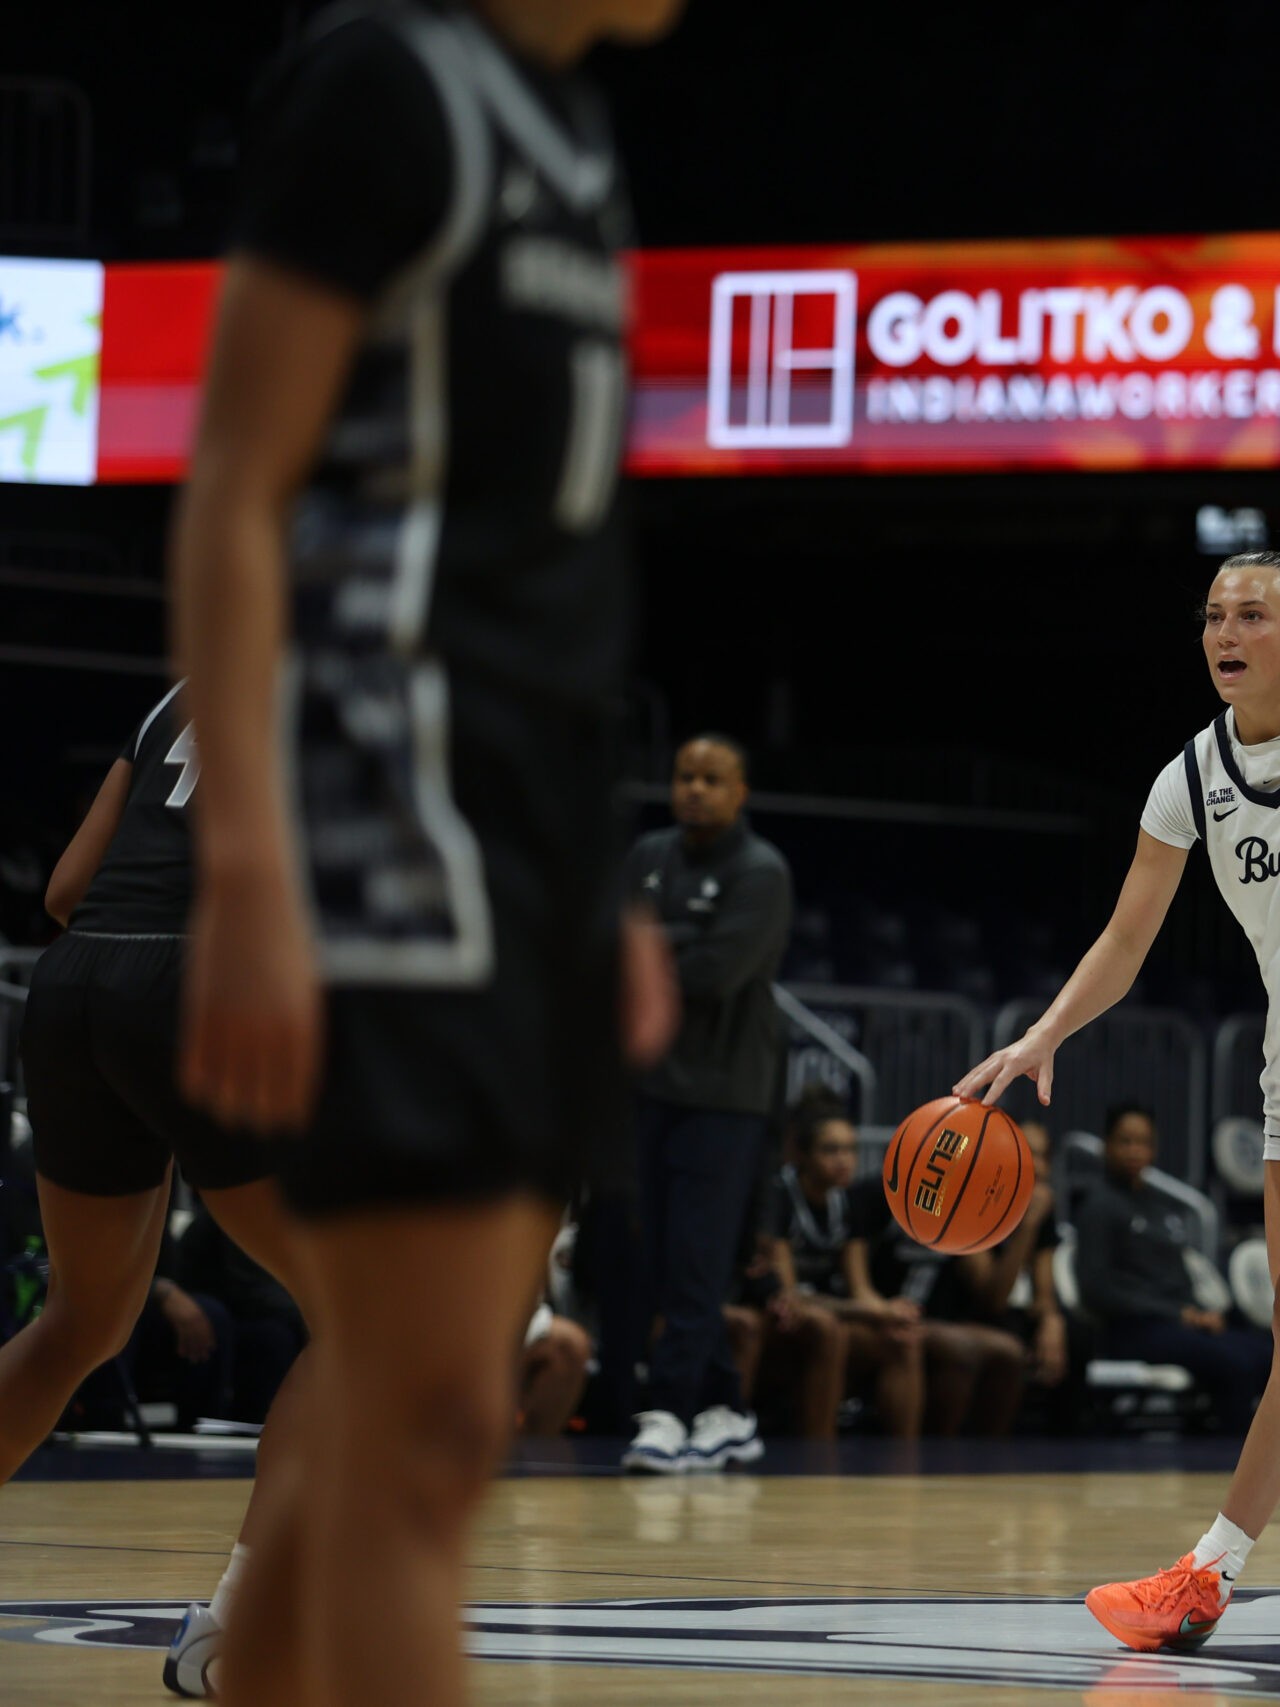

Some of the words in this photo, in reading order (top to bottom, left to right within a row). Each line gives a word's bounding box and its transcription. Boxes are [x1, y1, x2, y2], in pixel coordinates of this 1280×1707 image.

[867, 285, 1194, 367] GOLITKO
[1203, 282, 1260, 361] &
[1206, 794, 1235, 806] CHANGE
[1208, 790, 1217, 799] BE
[1219, 787, 1233, 796] THE
[913, 1127, 965, 1214] ELITE
